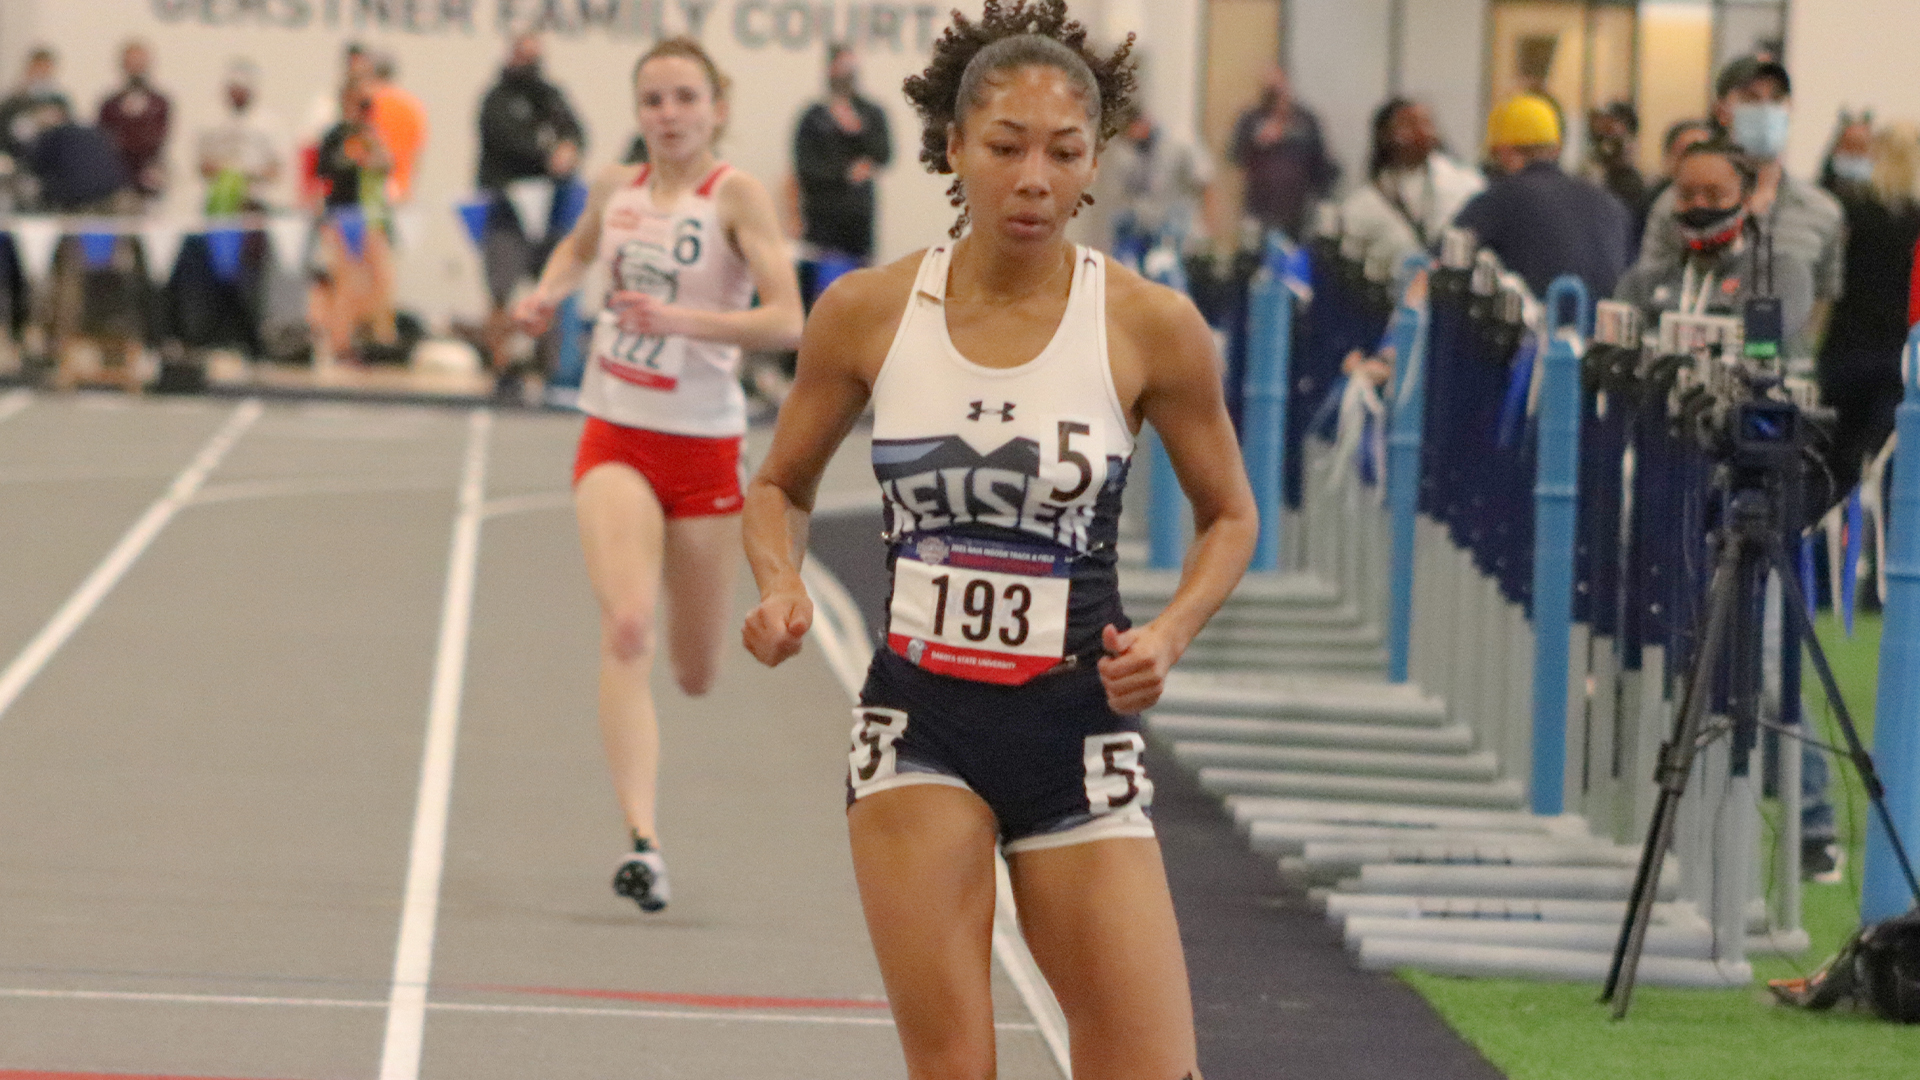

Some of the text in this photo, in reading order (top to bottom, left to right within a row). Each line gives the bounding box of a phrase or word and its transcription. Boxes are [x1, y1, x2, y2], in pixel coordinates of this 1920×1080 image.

[732, 3, 937, 52] COURT
[673, 217, 702, 265] 6
[1050, 421, 1092, 501] 5
[1010, 551, 1031, 561] TRACK
[1038, 554, 1056, 563] FIELD
[932, 574, 1031, 646] 193
[931, 650, 1017, 669] DAKOTA STATE UNIVERSITY
[857, 711, 893, 781] 5
[1102, 740, 1139, 807] 5
